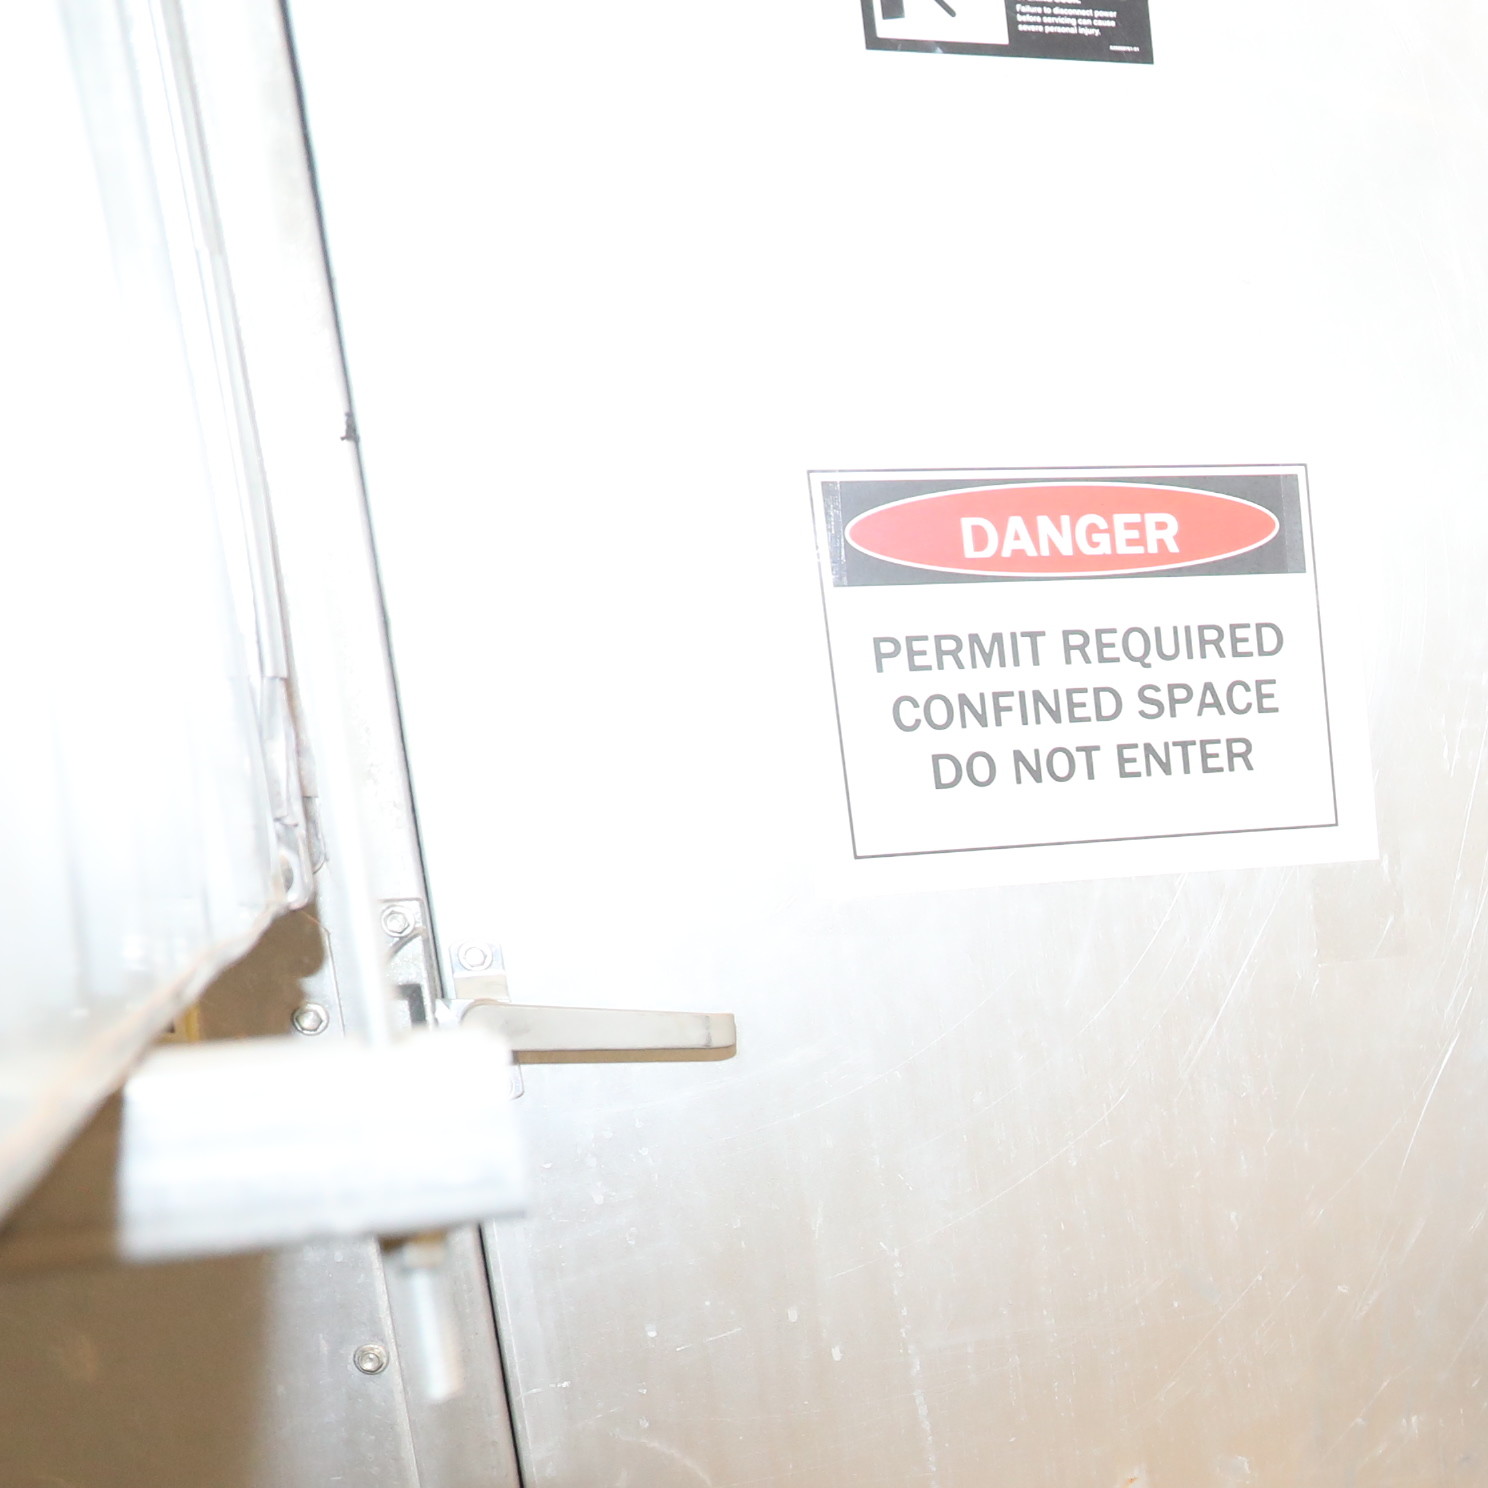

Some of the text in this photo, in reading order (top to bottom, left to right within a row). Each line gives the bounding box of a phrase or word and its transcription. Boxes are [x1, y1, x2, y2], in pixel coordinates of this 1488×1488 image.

[1016, 4, 1117, 18] Failure to disconnect power
[1016, 14, 1041, 23] before
[1042, 16, 1077, 26] servicing
[1093, 19, 1116, 27] cause
[1018, 23, 1043, 32] severe
[1044, 24, 1077, 34] personal
[960, 512, 1180, 559] DANGER
[873, 622, 1285, 673] PERMIT REQUIRED
[892, 679, 1280, 733] CONFINED SPACE
[931, 737, 1254, 790] DO NOT ENTER
